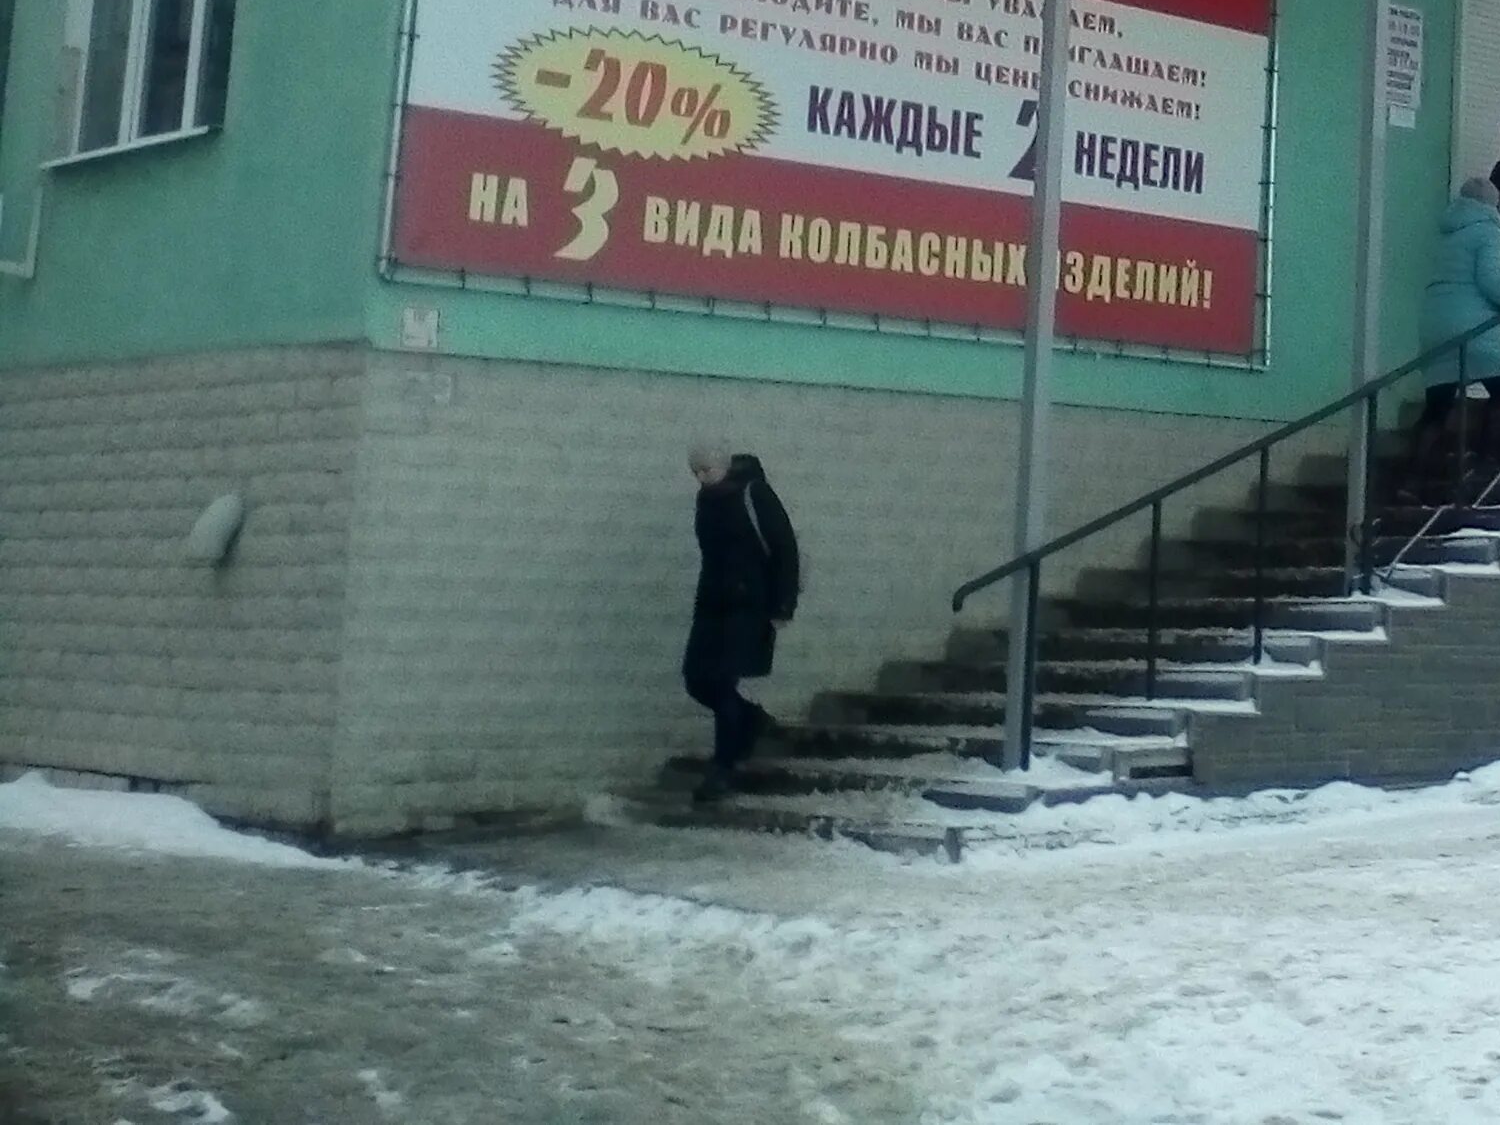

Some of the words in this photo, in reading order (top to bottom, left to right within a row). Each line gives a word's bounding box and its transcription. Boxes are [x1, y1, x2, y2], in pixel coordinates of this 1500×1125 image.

[640, 0, 701, 28] ВАС
[720, 14, 898, 65] РЕГУЛЯРНО
[915, 50, 959, 75] МЫ
[1068, 79, 1201, 120] СНИЖАЕМ!
[896, 10, 942, 36] МЫ
[957, 20, 1009, 49] ВАС
[535, 48, 731, 145] -20%
[808, 86, 984, 159] КАЖДЫЕ
[1075, 130, 1205, 194] НЕДЕЛИ
[469, 173, 528, 226] НА
[552, 157, 619, 261] 3
[643, 196, 763, 258] ВИДА
[779, 213, 1027, 286] КОЛБАСНЫХ
